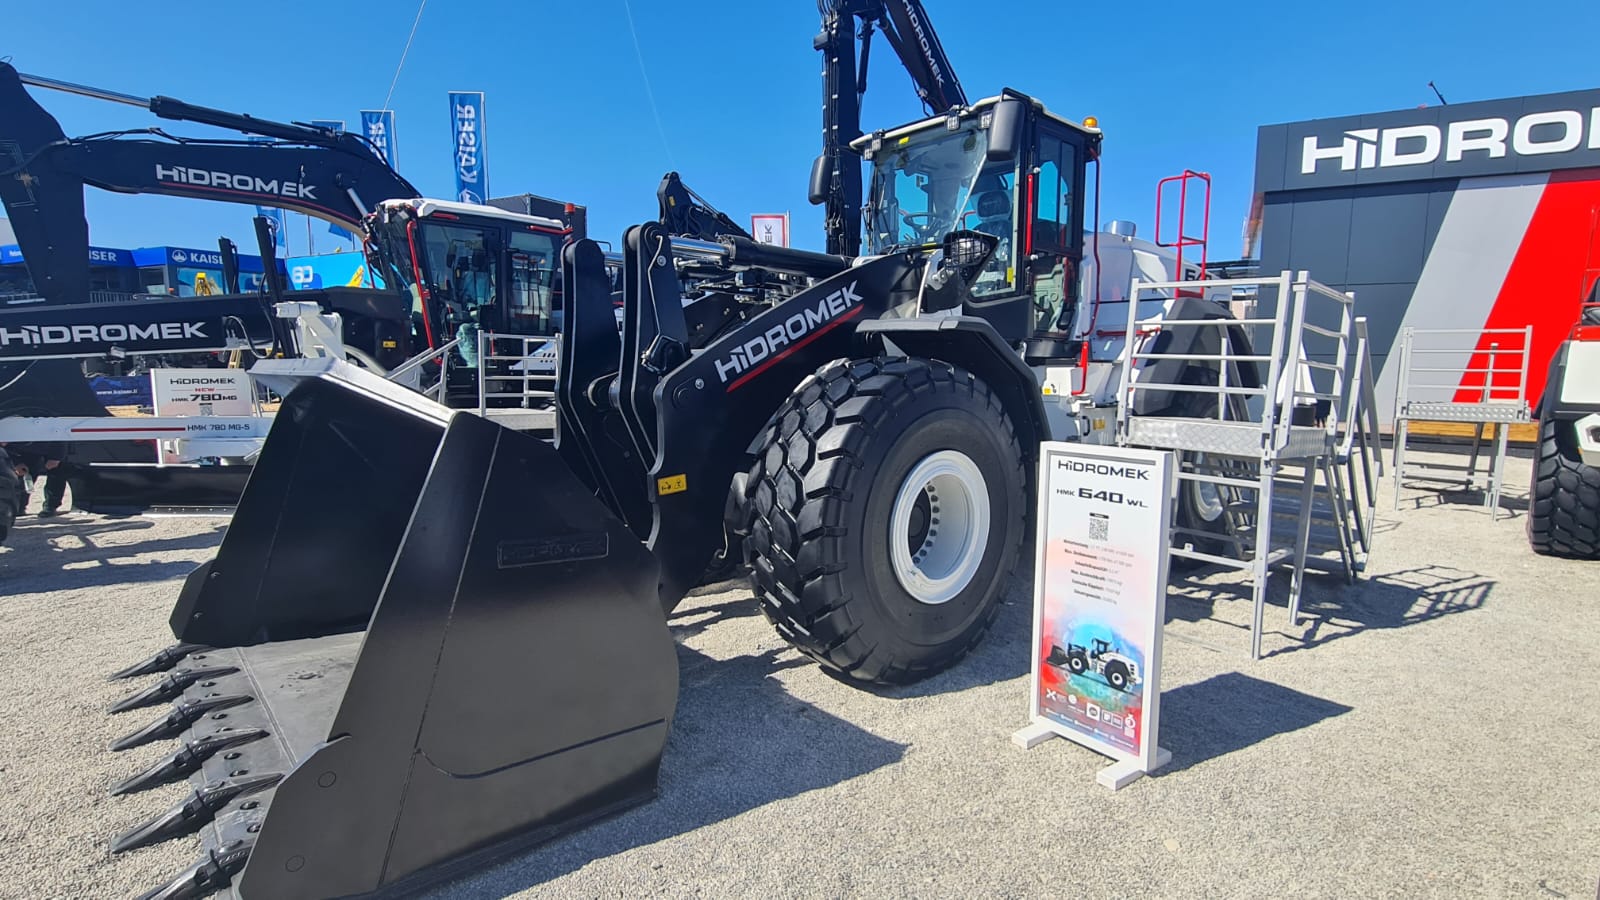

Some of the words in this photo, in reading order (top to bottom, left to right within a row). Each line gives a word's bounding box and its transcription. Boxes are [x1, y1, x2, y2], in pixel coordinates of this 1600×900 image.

[1301, 106, 1600, 174] HiDRO
[155, 163, 318, 200] HiDROMEK
[0, 321, 209, 346] HiDROMEK
[714, 280, 864, 383] HiDROMEK
[1057, 459, 1149, 481] HiDROMEK
[1056, 488, 1076, 497] HMK
[1078, 487, 1123, 504] 640
[1126, 498, 1149, 508] WL
